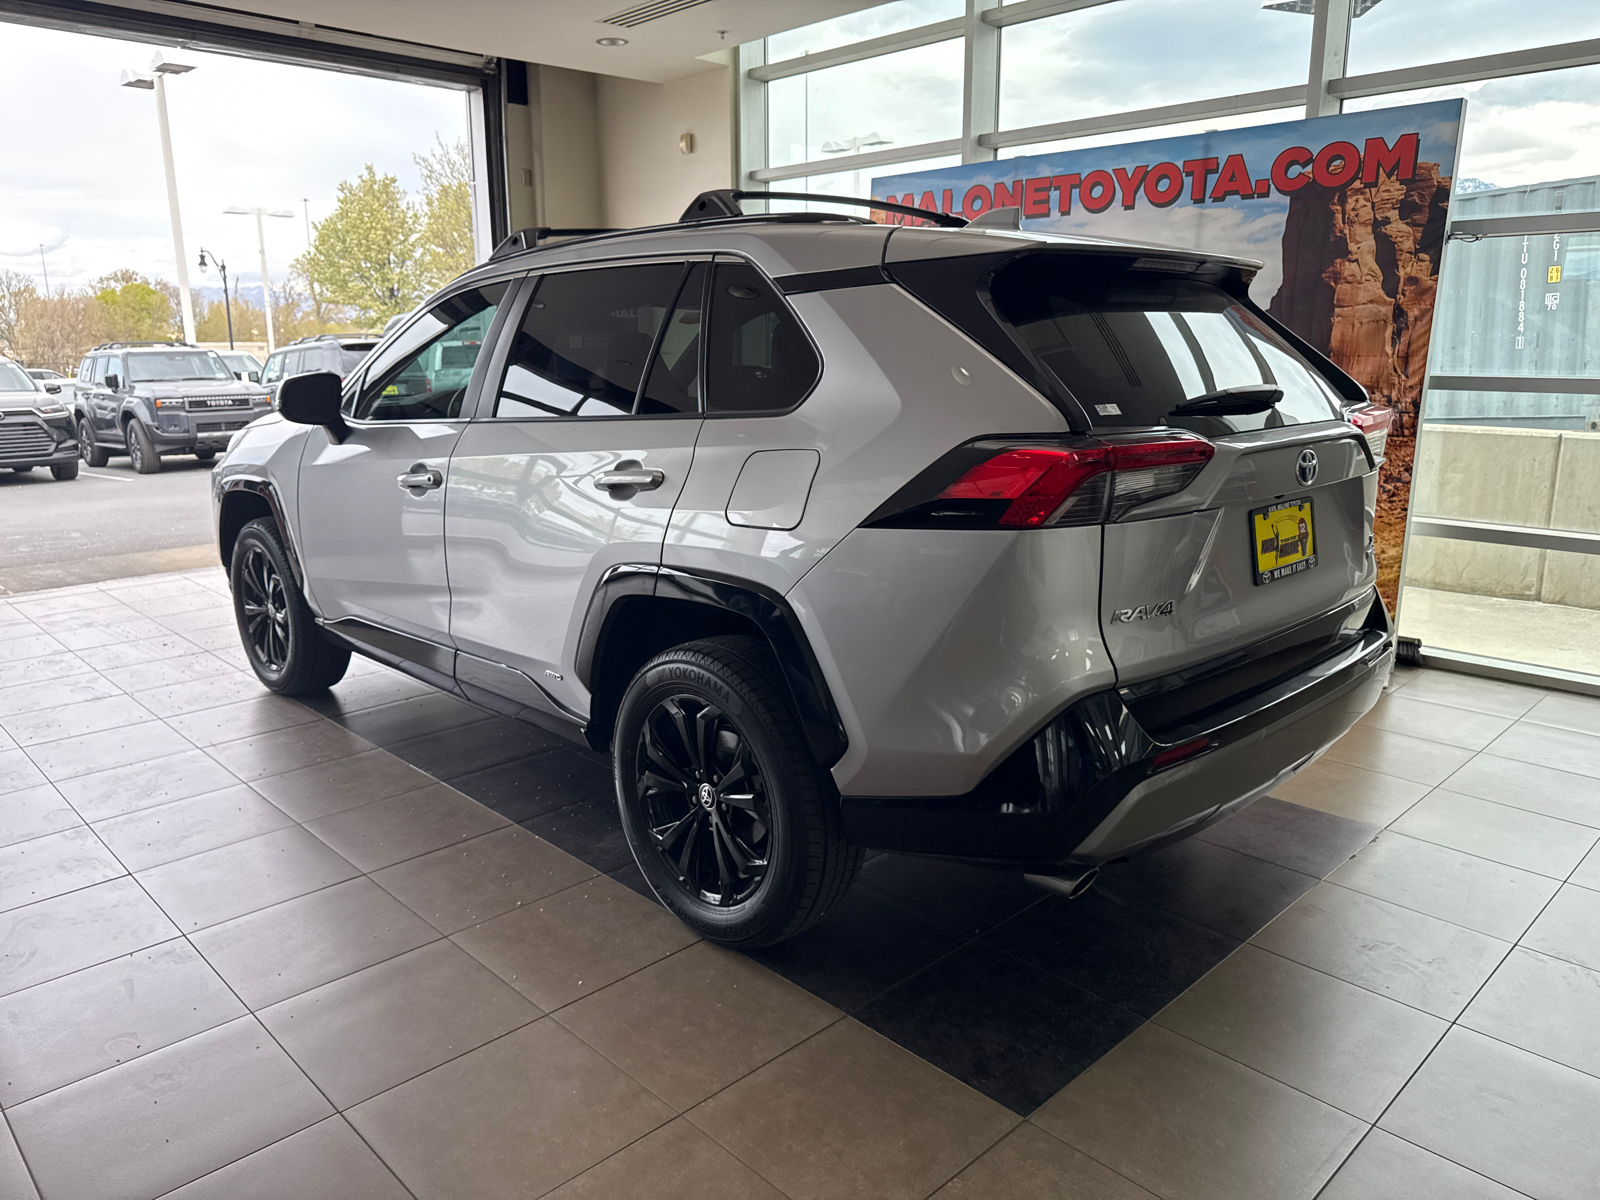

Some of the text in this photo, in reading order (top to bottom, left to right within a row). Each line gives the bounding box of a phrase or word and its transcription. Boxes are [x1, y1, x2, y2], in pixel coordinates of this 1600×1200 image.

[1299, 522, 1306, 534] 32
[1274, 569, 1281, 579] WE
[1281, 565, 1292, 577] MAKE
[1296, 560, 1306, 572] EASY
[1109, 599, 1175, 625] RAV4
[667, 665, 731, 704] YOKOHAMA
